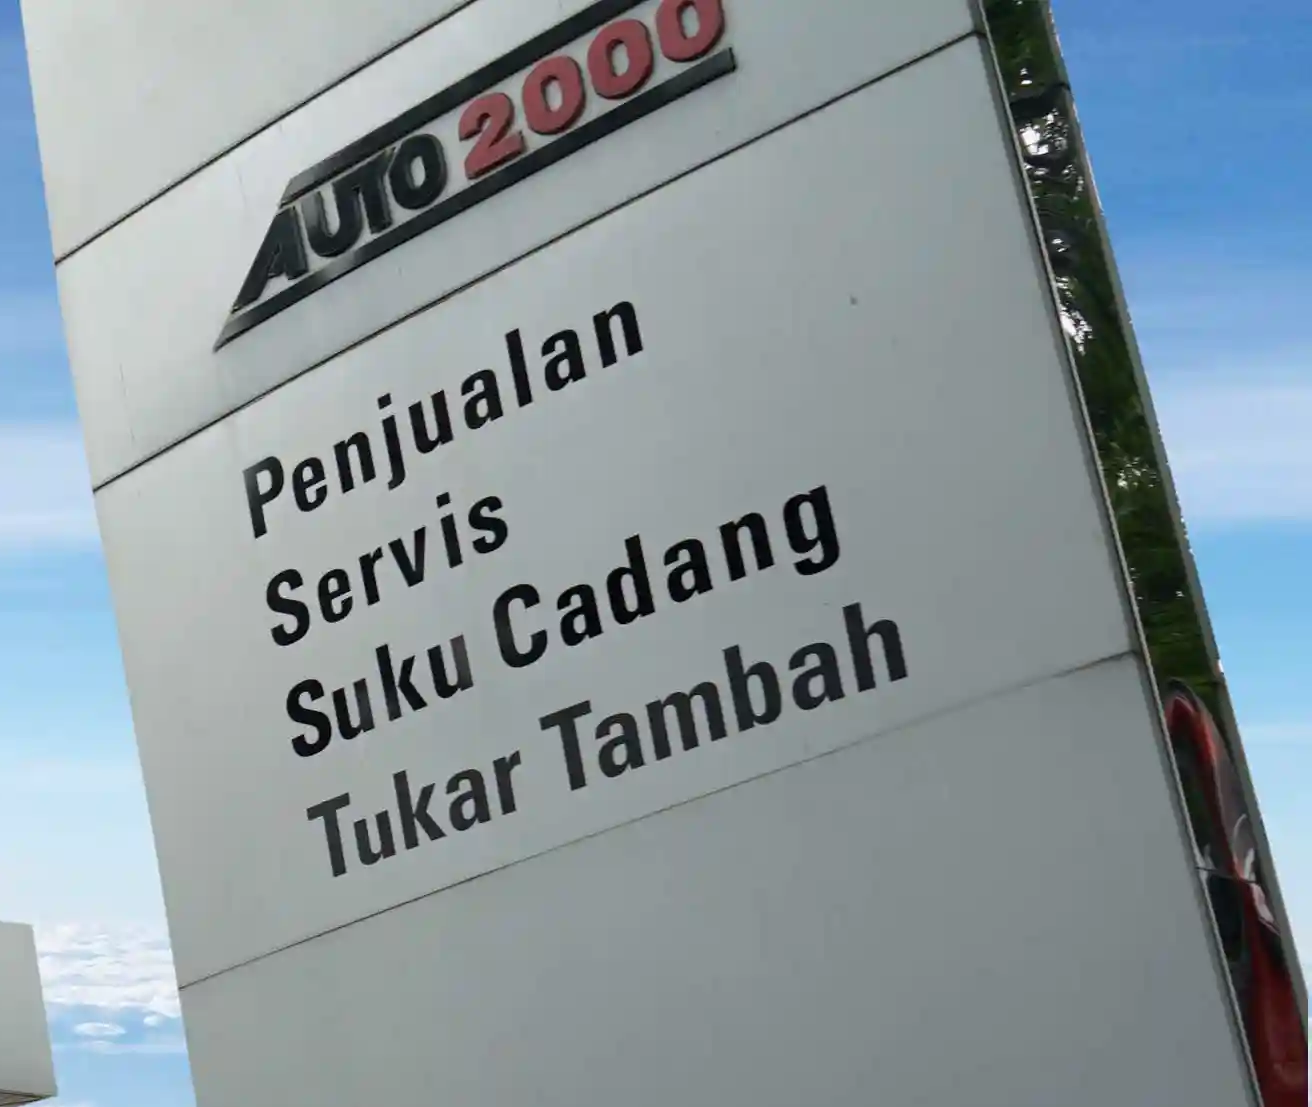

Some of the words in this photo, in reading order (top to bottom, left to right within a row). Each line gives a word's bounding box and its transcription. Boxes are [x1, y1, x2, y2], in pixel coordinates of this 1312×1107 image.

[231, 133, 448, 313] AUTO
[458, 0, 726, 180] 2000
[242, 301, 644, 538] Penjualan
[265, 492, 509, 646] Servis
[286, 634, 474, 757] Suku
[493, 485, 841, 668] Cadang
[306, 750, 521, 877] Tukar
[539, 603, 908, 791] Tambah
